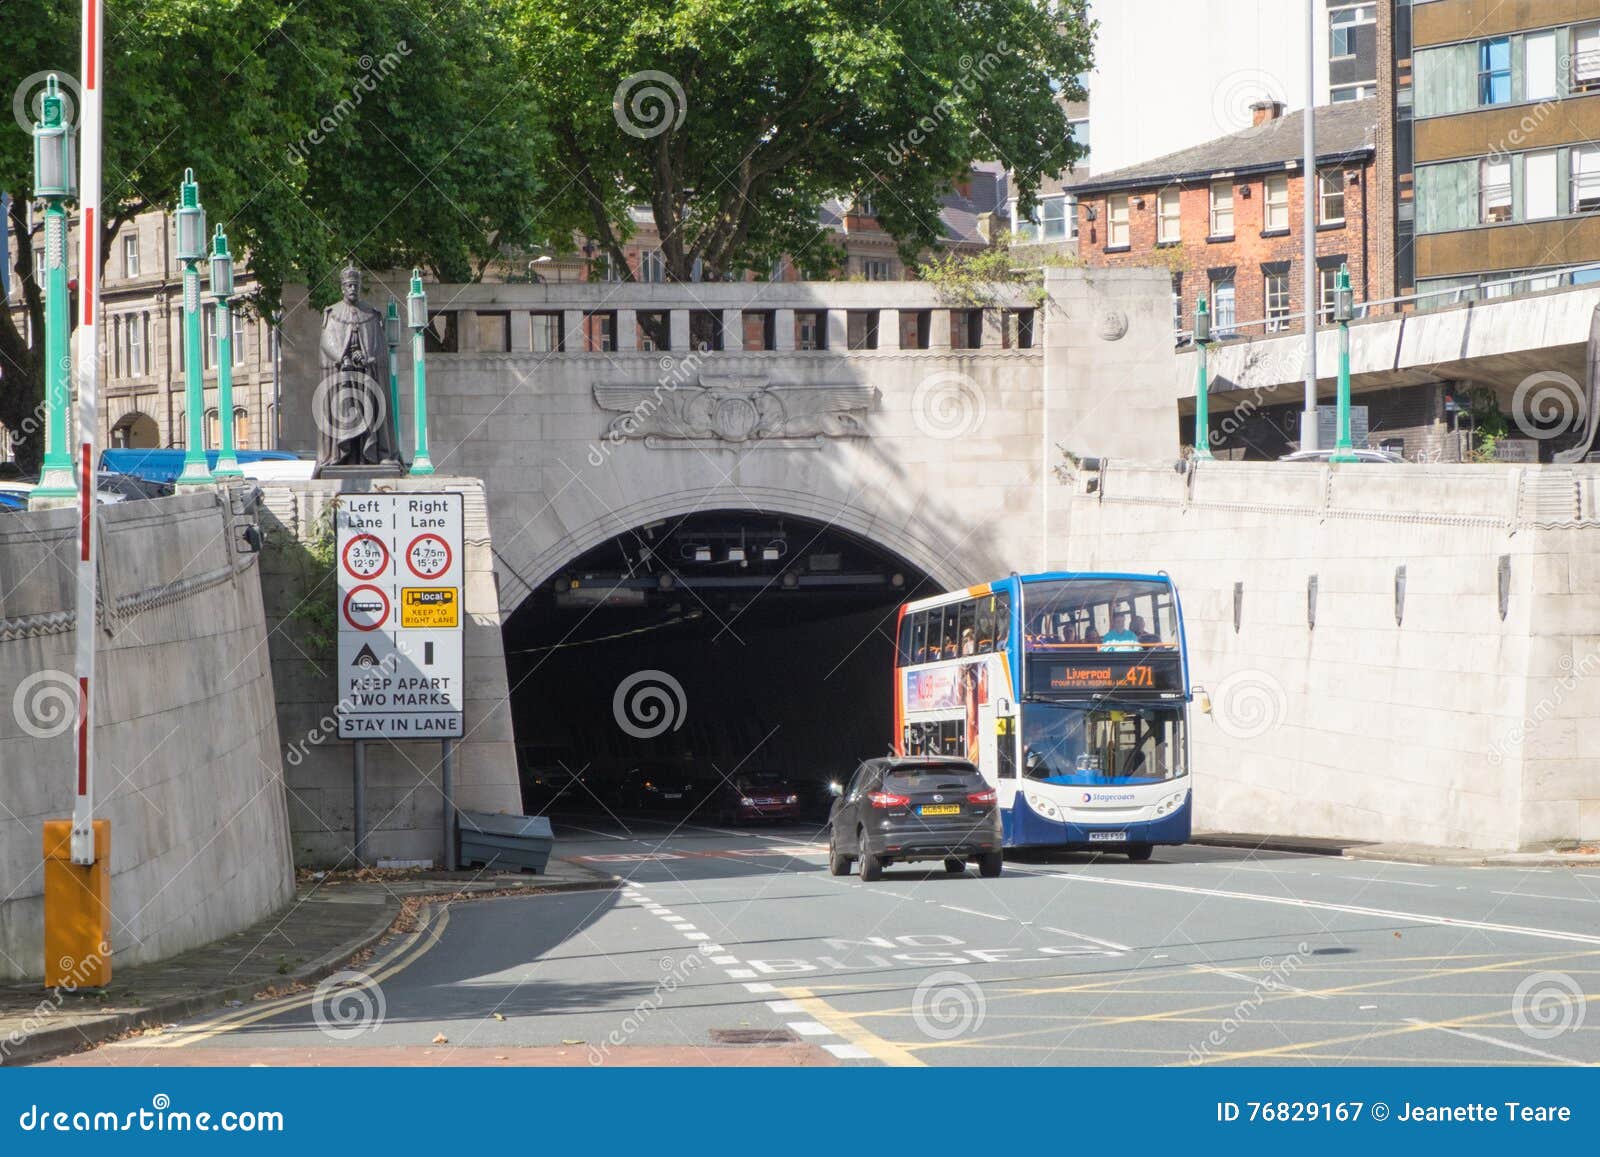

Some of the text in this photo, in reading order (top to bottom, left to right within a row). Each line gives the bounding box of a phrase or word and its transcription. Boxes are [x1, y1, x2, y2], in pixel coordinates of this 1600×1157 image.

[350, 500, 380, 513] Left
[408, 500, 449, 514] Right
[347, 516, 383, 528] Lane
[411, 516, 446, 528] Lane
[353, 547, 381, 558] 3.9m
[412, 547, 446, 559] 4.75m
[421, 591, 443, 601] local
[405, 616, 455, 624] RIGHT LANE
[1066, 667, 1112, 680] Liverpool
[1126, 665, 1153, 687] 471
[350, 677, 450, 690] KEEP APART
[350, 693, 451, 706] TWO MARKS
[344, 718, 458, 732] STAY IN LANE
[1092, 793, 1136, 803] Stagecoach
[818, 934, 966, 949] NO
[746, 945, 1127, 974] BUSES
